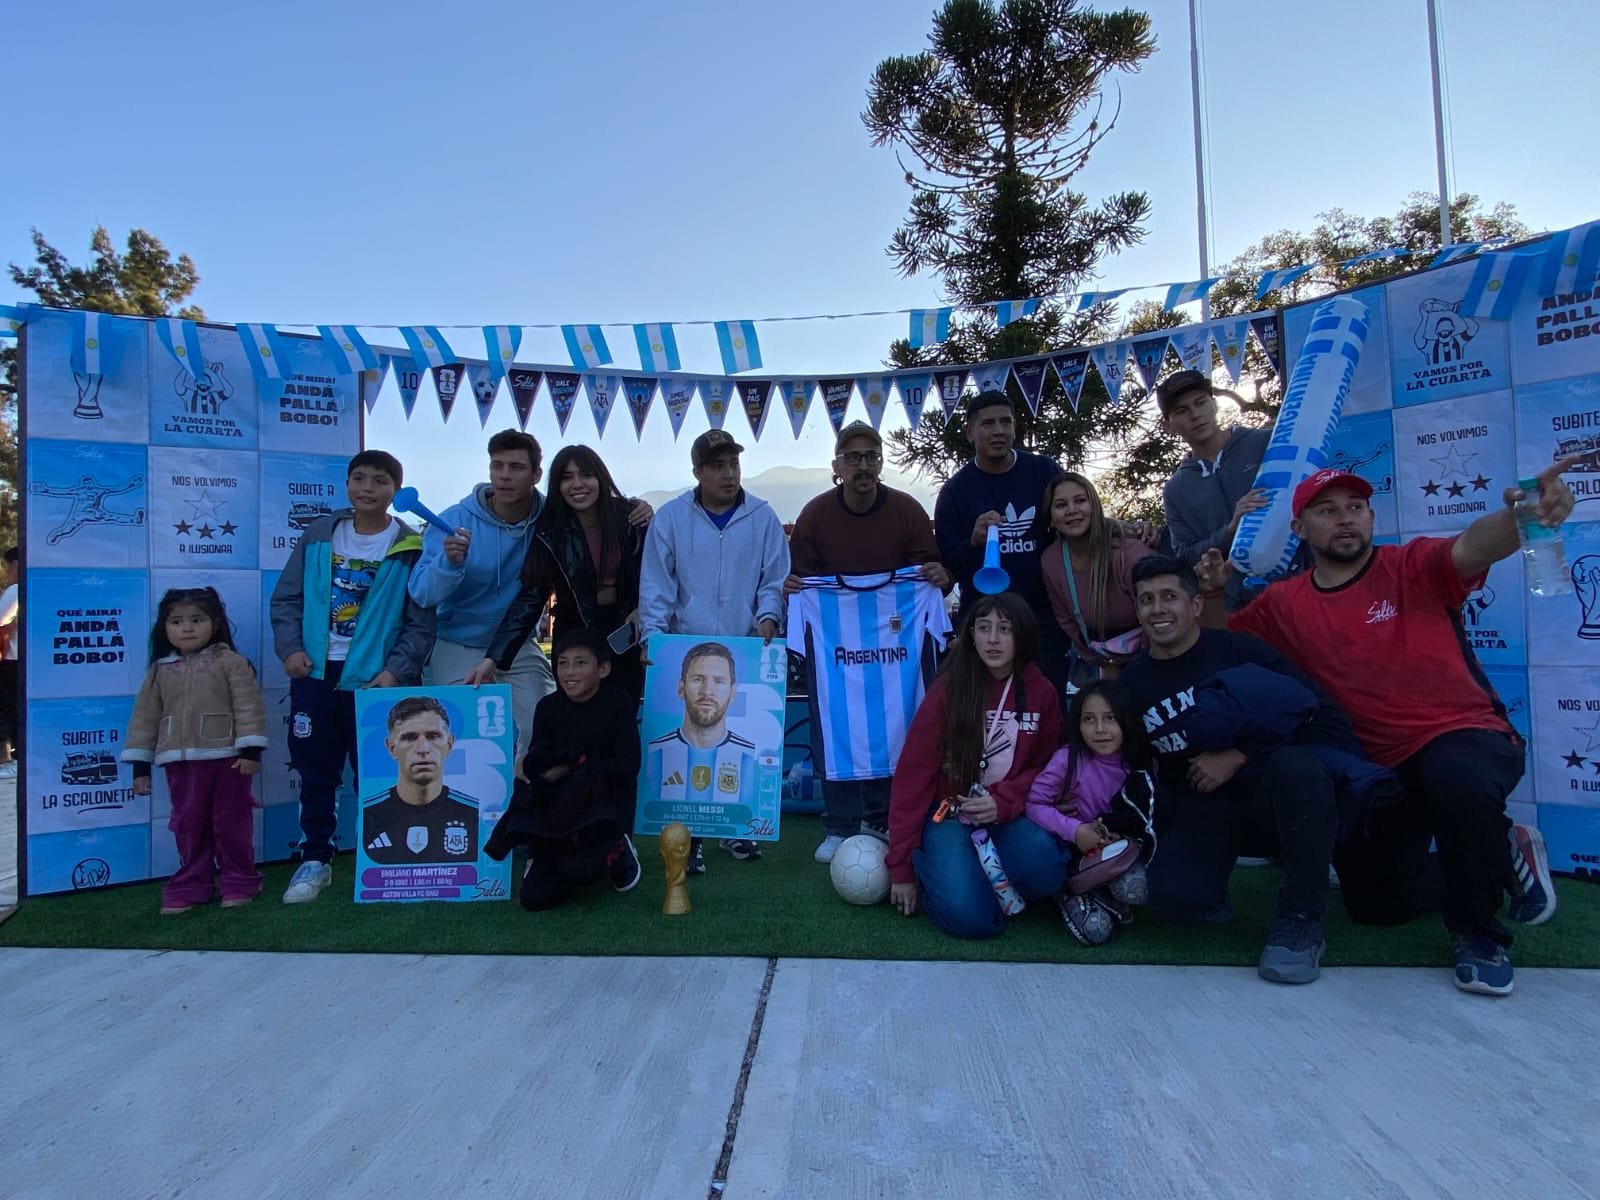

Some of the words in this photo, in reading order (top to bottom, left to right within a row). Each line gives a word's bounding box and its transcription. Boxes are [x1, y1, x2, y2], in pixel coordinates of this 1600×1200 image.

[1413, 365, 1457, 379] VAMOS
[1459, 360, 1484, 372] POR
[401, 371, 418, 390] 10
[1406, 380, 1425, 391] LA
[1428, 368, 1492, 387] CUARTA
[284, 383, 334, 398] ANDÁ
[905, 387, 923, 406] 10
[171, 415, 213, 426] VAMOS
[215, 419, 236, 427] POR
[280, 411, 339, 426] BOBO!
[164, 424, 182, 432] LA
[186, 426, 243, 437] CUARTA
[1417, 433, 1437, 446] NOS
[1440, 425, 1488, 442] VOLVIMOS
[171, 476, 191, 487] NOS
[194, 477, 237, 488] VOLVIMOS
[288, 482, 324, 496] SUBITE
[327, 484, 335, 496] A
[1428, 505, 1434, 517] A
[1437, 501, 1486, 515] ILUSIONAR
[179, 544, 186, 554] A
[188, 544, 233, 555] ILUSIONAR
[272, 536, 285, 549] LA
[1000, 538, 1036, 554] dida
[59, 617, 120, 633] ANDÁ
[53, 632, 125, 649] PALLÁ
[1475, 630, 1499, 638] POR
[53, 651, 125, 665] BOBO!
[834, 646, 908, 667] ARGENTINA
[1557, 699, 1582, 711] NOS
[62, 730, 105, 746] SUBITE
[110, 729, 119, 743] A
[1570, 779, 1578, 790] A
[42, 794, 58, 809] LA
[63, 788, 135, 808] SCALONETA
[699, 805, 724, 814] MESSI
[381, 869, 411, 878] EMILIANO
[412, 867, 458, 877] MARTÍNEZ
